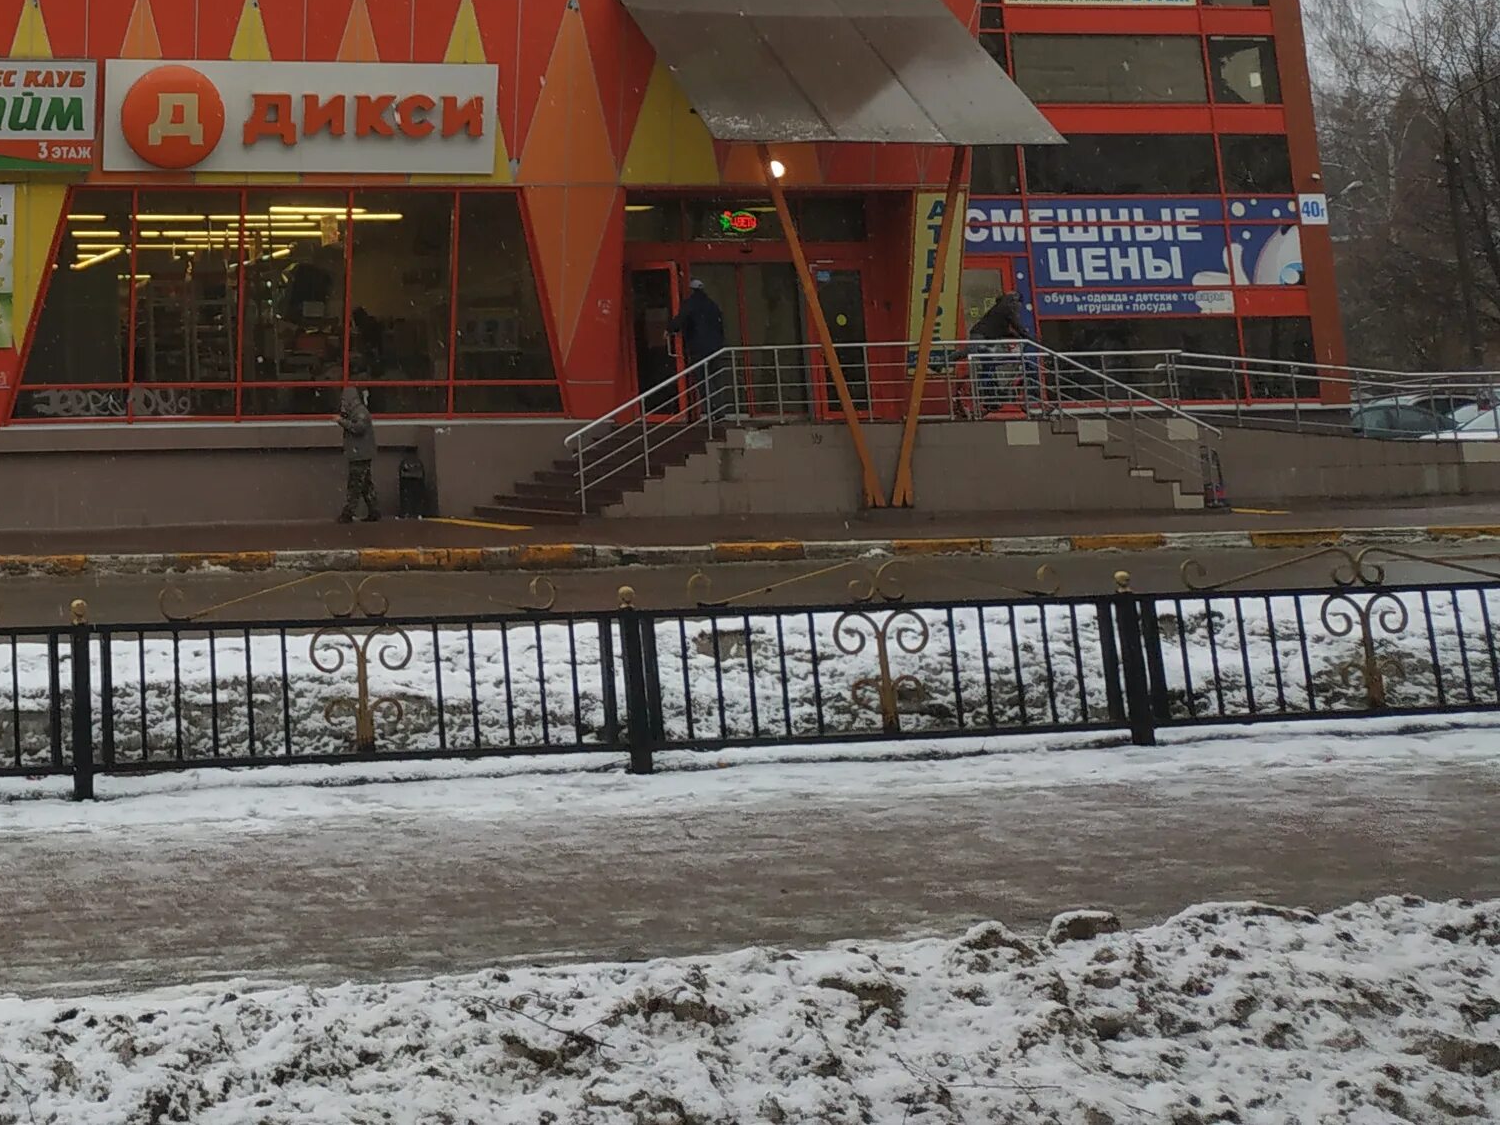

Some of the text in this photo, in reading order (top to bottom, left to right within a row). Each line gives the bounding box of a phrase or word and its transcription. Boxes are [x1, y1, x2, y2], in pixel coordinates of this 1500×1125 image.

[23, 71, 86, 88] КЛУБ
[148, 93, 204, 146] Д
[243, 93, 485, 147] ДИКСИ
[38, 142, 91, 159] 3 ЭТАЖ
[965, 208, 1202, 242] СМЕШНЫЕ
[1047, 247, 1183, 287] ЦЕНЫ
[1044, 293, 1080, 304] обувь
[1087, 294, 1128, 302] одежда
[1134, 293, 1178, 303] детские
[1076, 303, 1172, 313] игрушки посуда
